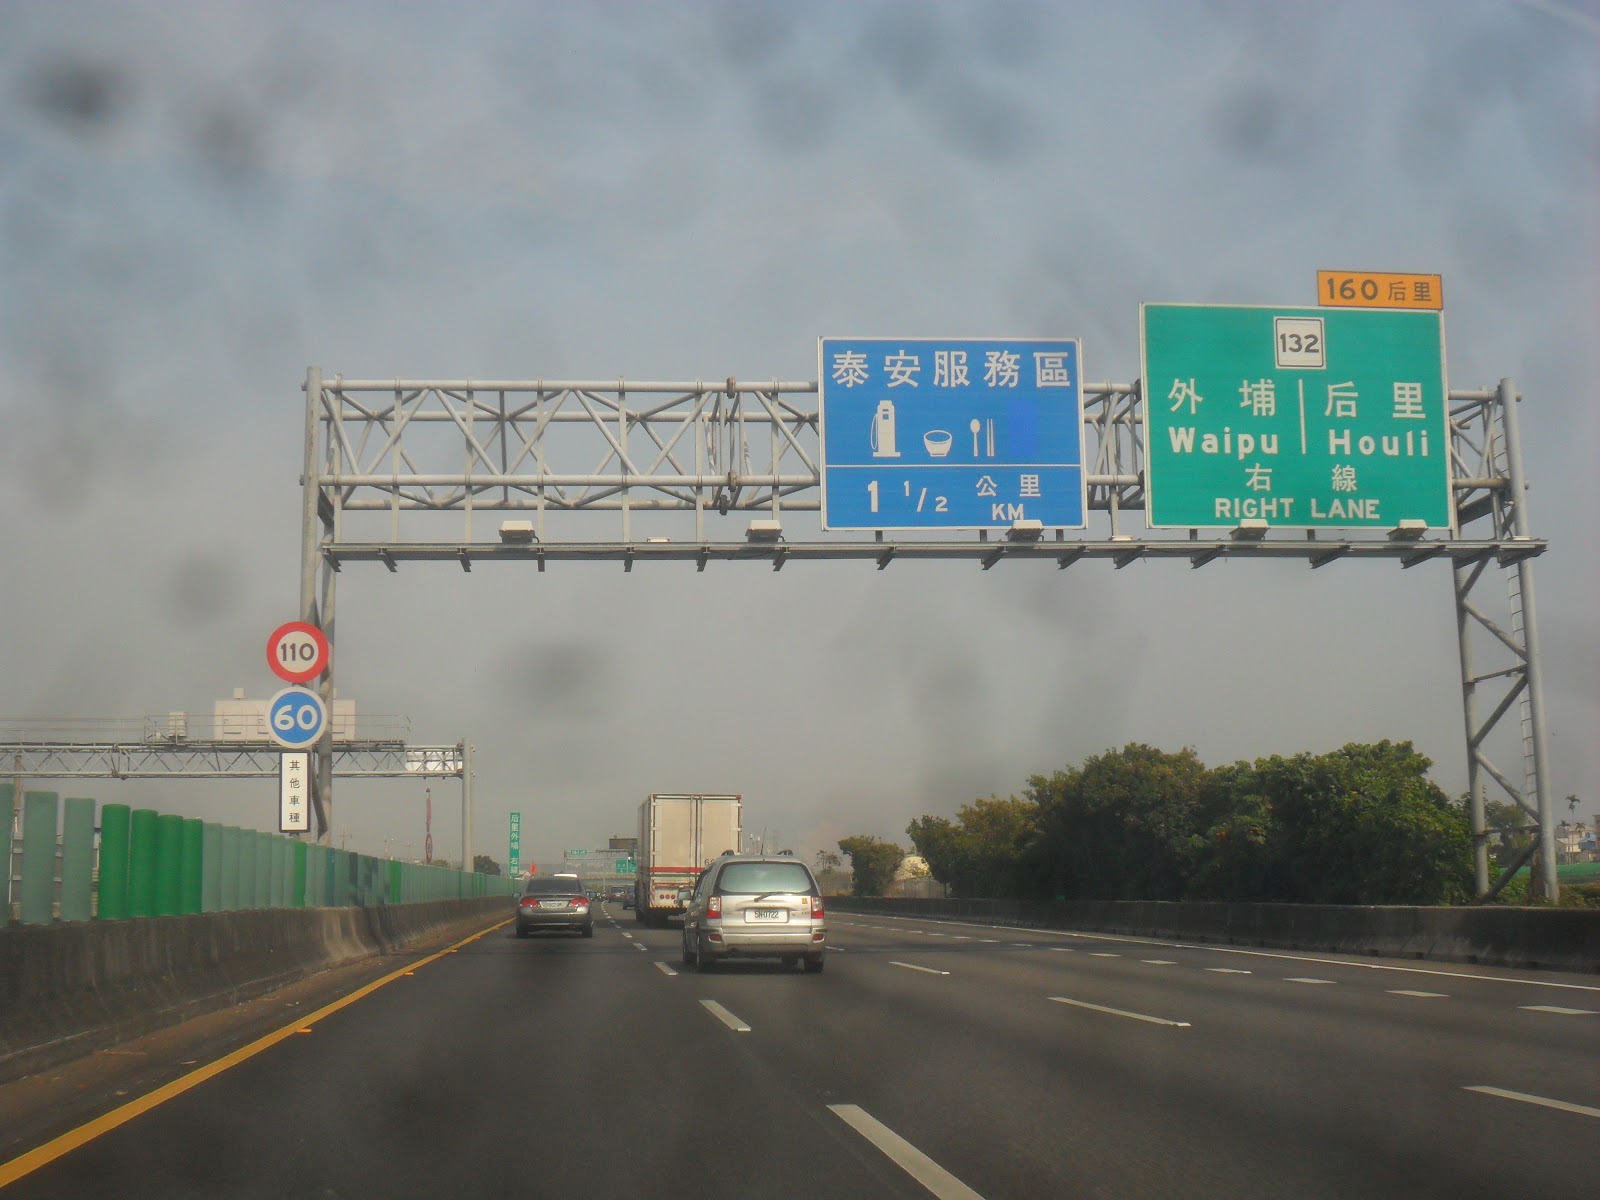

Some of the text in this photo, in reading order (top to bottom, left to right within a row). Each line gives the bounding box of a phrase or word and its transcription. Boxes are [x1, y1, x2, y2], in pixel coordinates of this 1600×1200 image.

[1326, 277, 1433, 302] 160 后里
[1279, 333, 1320, 354] 132
[831, 349, 1071, 388] 泰安服務區
[1167, 378, 1276, 417] 外埔
[1324, 381, 1426, 419] 后里
[1168, 426, 1279, 460] Waipu
[1328, 429, 1429, 456] Houli
[975, 474, 1042, 498] 公里
[1244, 463, 1358, 492] 右線
[991, 503, 1024, 521] KM
[1214, 497, 1381, 519] RIGHT LANE
[280, 643, 315, 662] 110
[274, 704, 318, 731] 60
[289, 760, 301, 823] 其他車種
